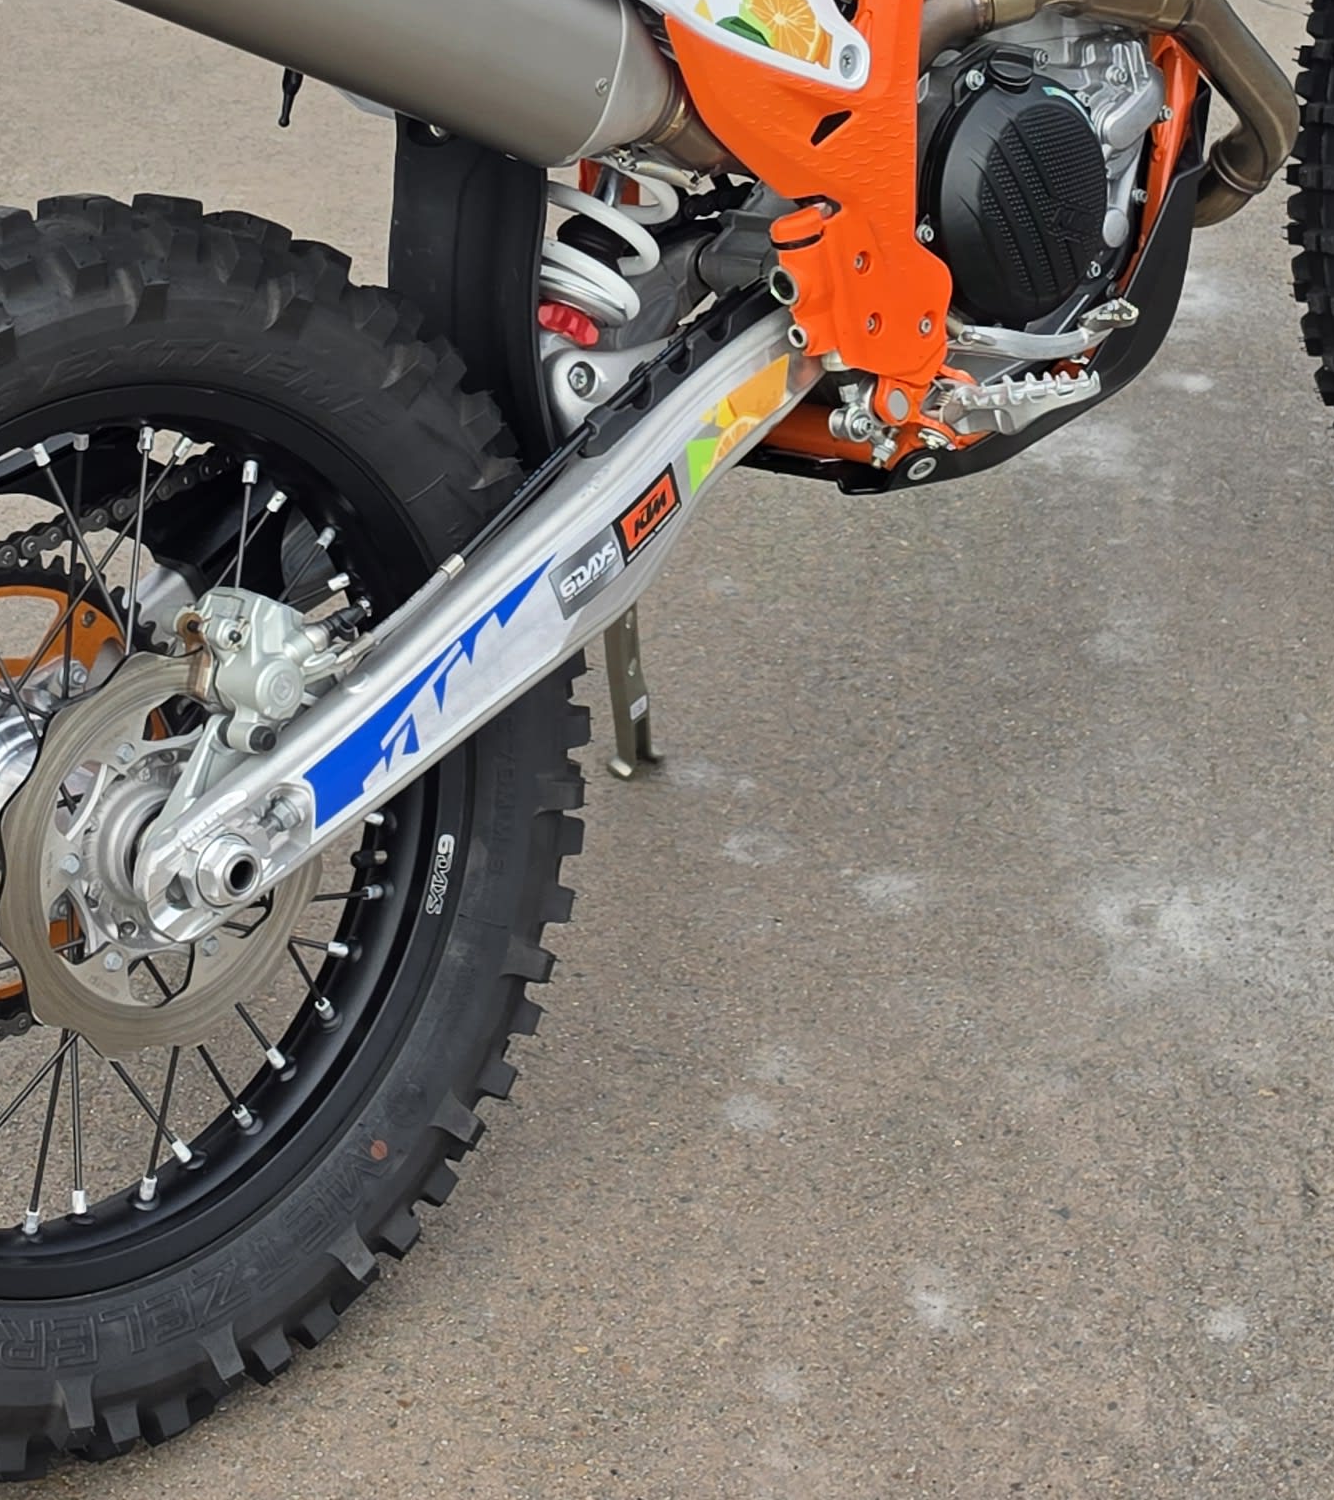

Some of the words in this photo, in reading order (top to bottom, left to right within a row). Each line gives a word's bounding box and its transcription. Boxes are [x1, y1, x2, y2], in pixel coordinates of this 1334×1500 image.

[634, 490, 667, 538] KTM
[558, 540, 618, 599] 6DAYS
[425, 833, 456, 915] 6DAYS
